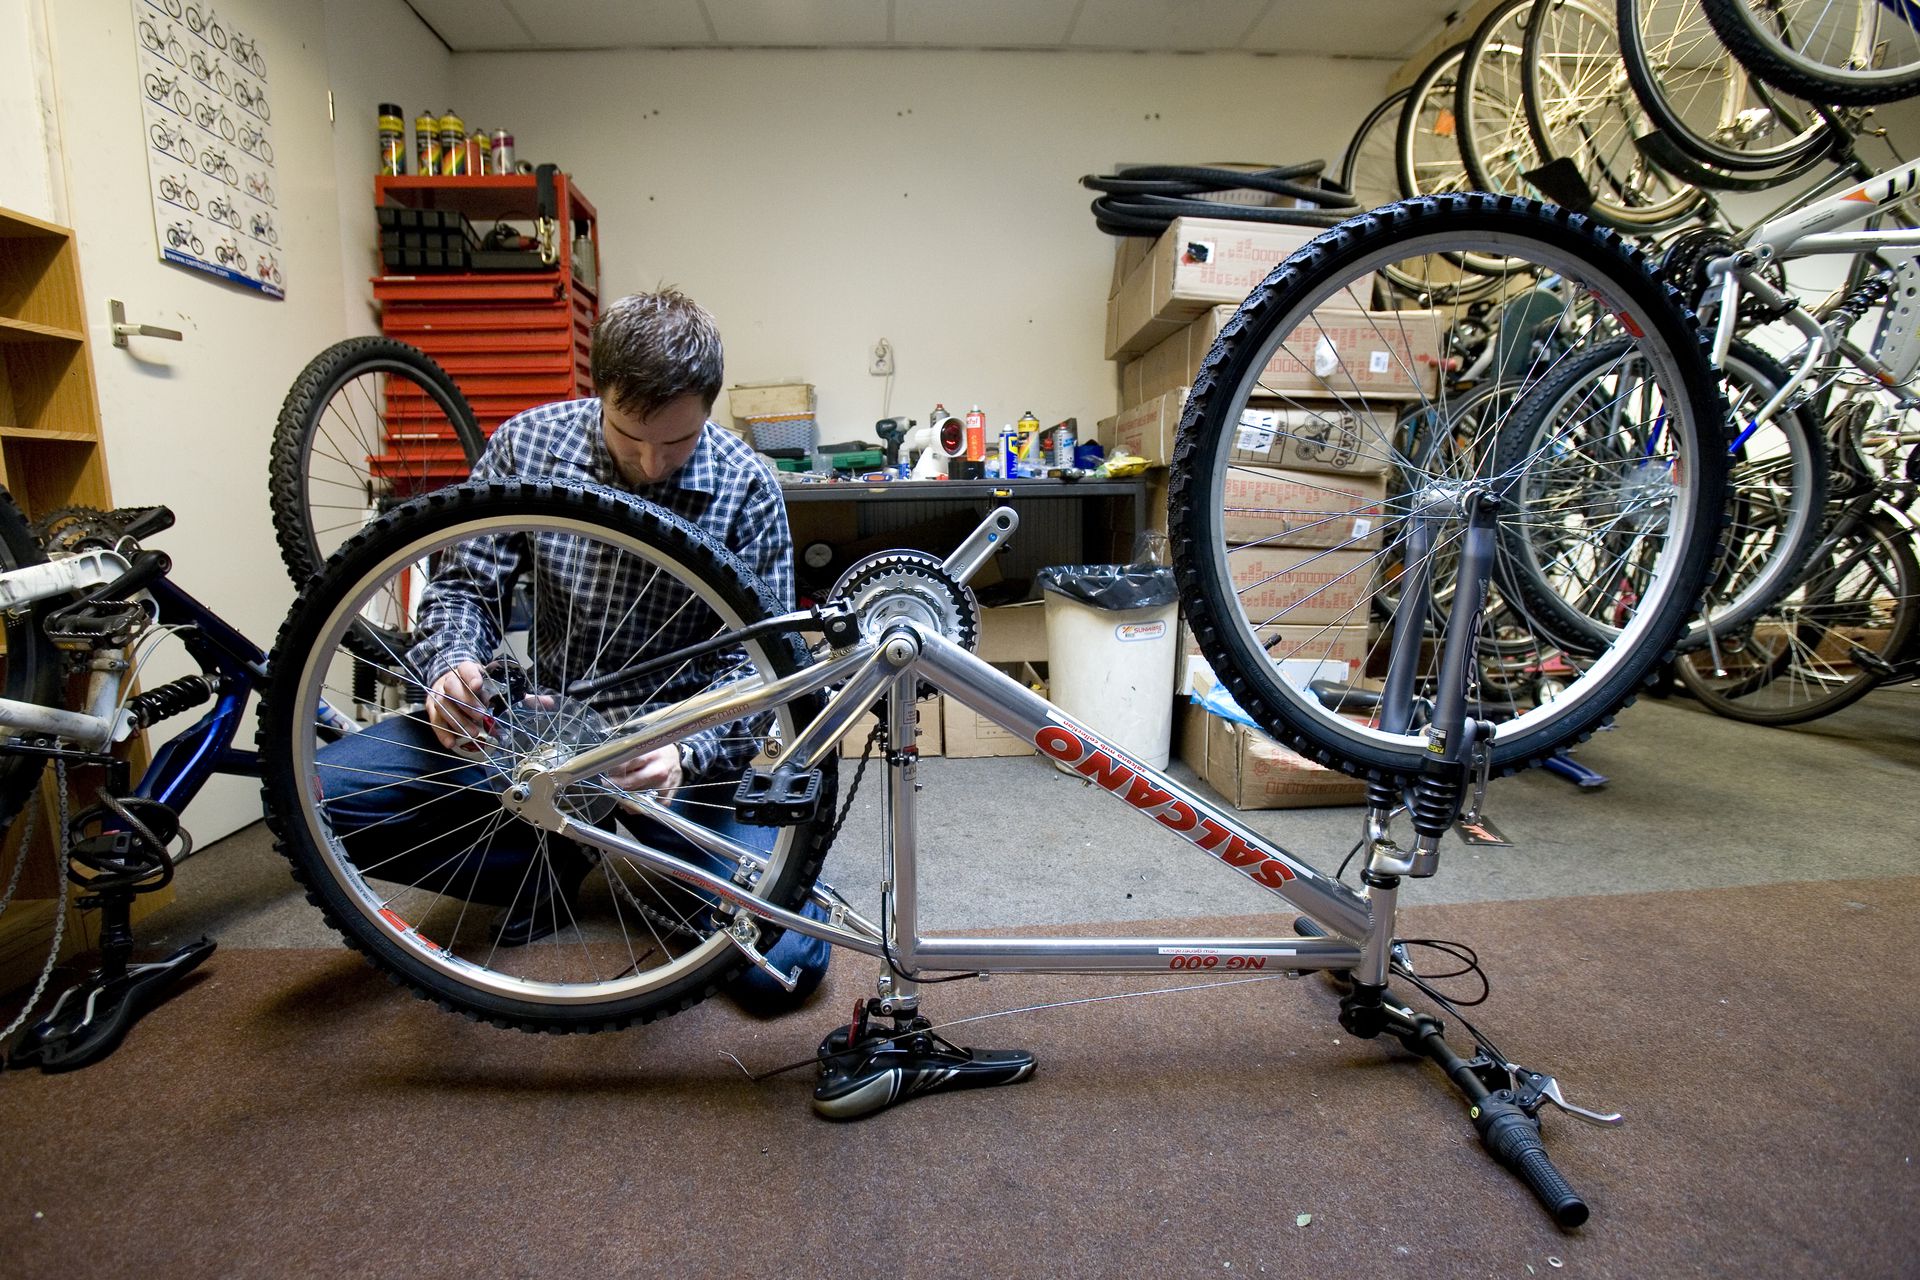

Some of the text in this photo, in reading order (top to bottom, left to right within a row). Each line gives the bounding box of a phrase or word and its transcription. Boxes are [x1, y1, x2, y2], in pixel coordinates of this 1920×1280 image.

[1062, 720, 1147, 774] salcano mtb collection
[1034, 725, 1298, 889] SALCANO
[672, 869, 718, 892] collection
[1169, 955, 1267, 971] NG 600
